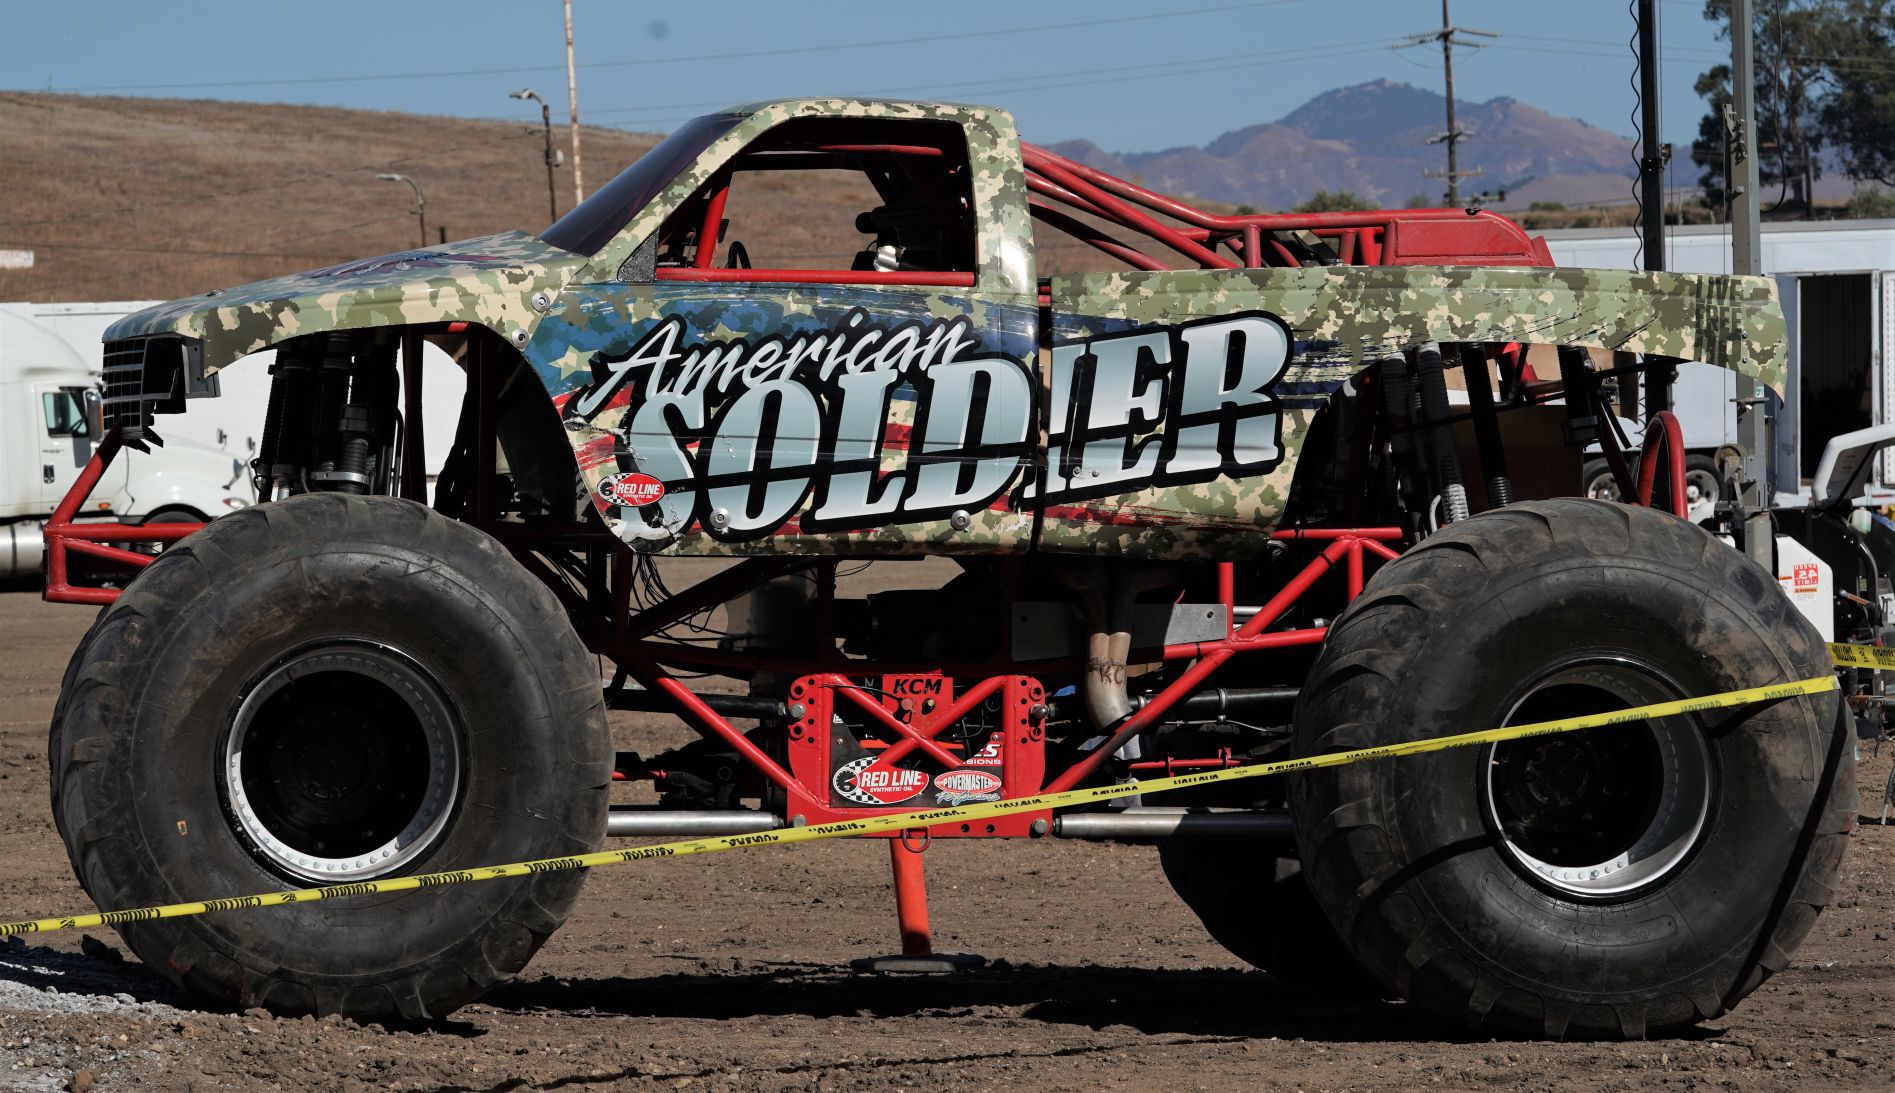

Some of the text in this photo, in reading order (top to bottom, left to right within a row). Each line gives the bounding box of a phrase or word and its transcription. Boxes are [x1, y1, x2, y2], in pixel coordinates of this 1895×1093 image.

[1695, 275, 1742, 306] LIVE
[1695, 303, 1742, 335] FREE
[577, 312, 976, 417] American
[608, 316, 1289, 543] SOLDIER
[616, 483, 661, 495] RED LINE
[893, 679, 942, 695] KCM
[861, 770, 922, 787] RED LINE
[943, 774, 993, 791] POWERMASTER
